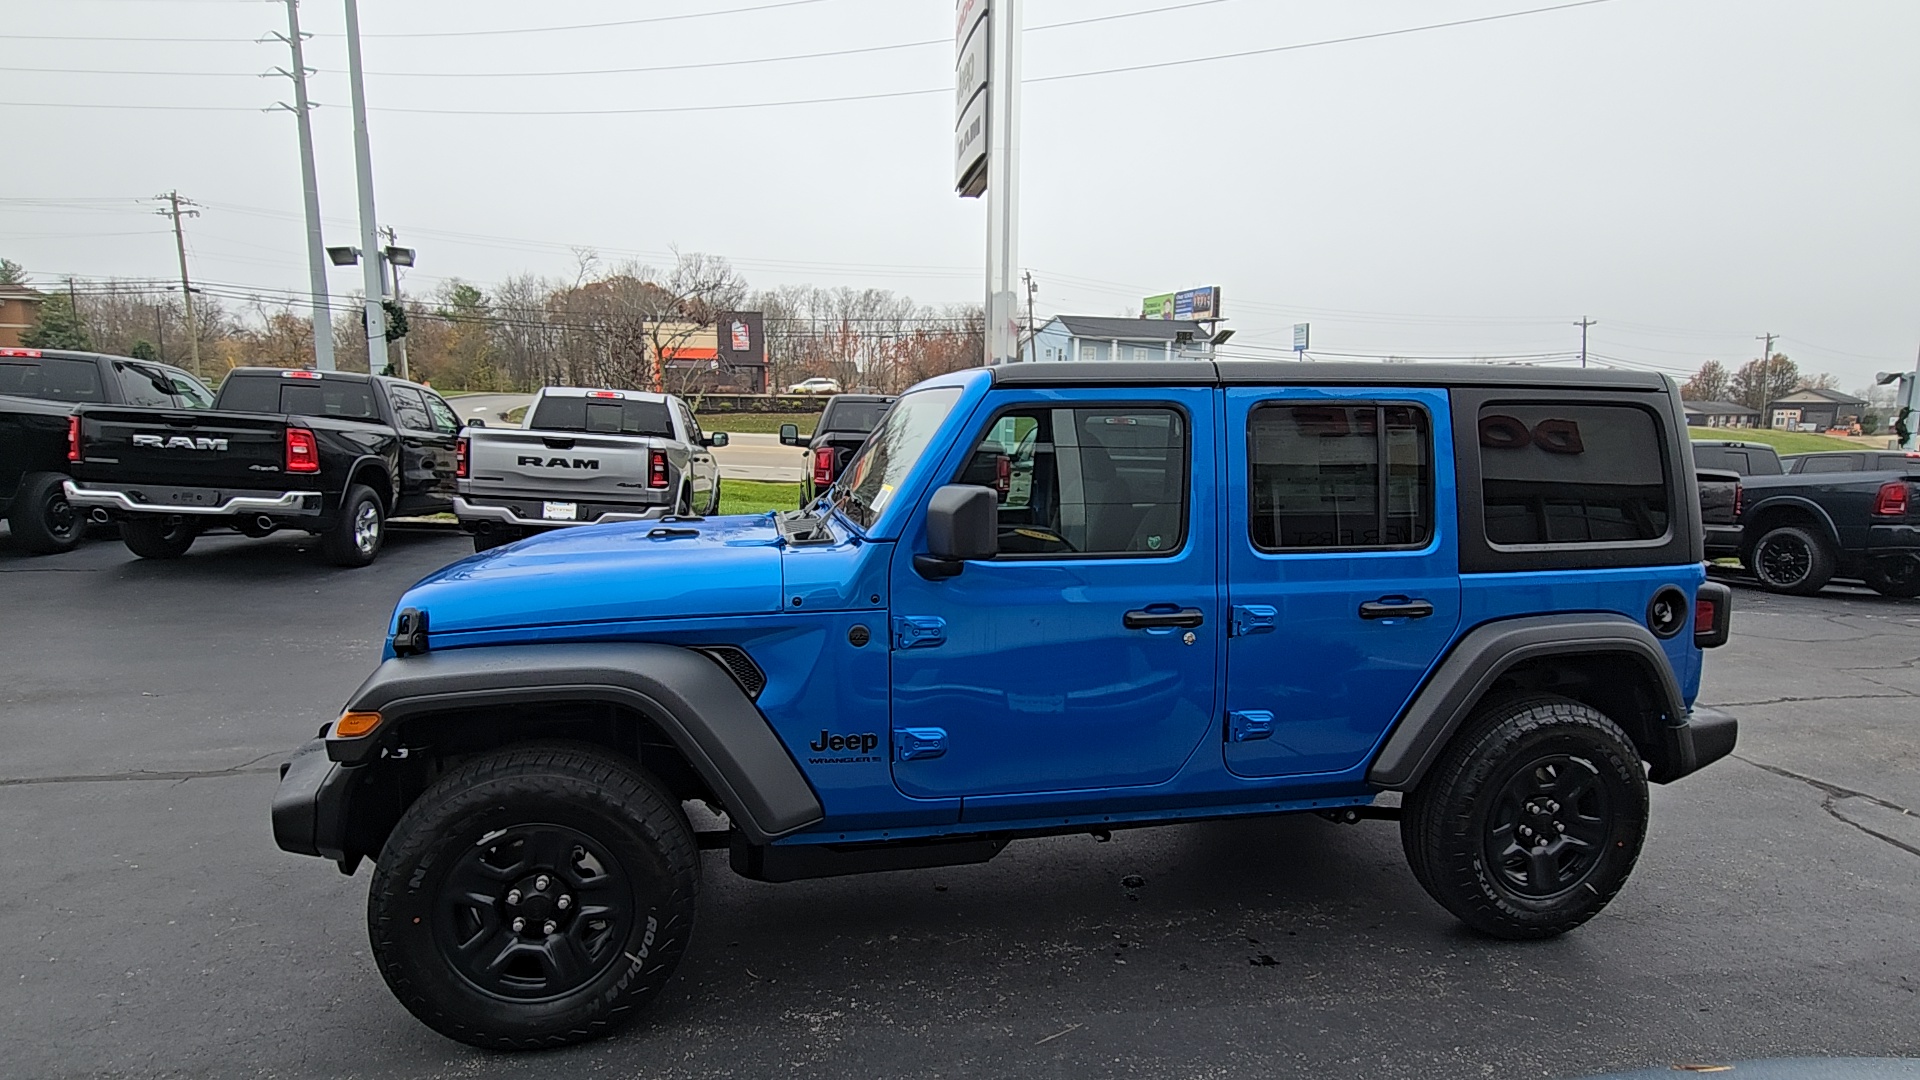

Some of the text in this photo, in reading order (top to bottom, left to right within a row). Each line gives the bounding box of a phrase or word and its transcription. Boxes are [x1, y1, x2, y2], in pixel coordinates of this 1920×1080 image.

[132, 434, 229, 451] RAM
[517, 455, 600, 470] RAM
[810, 728, 878, 754] Jeep
